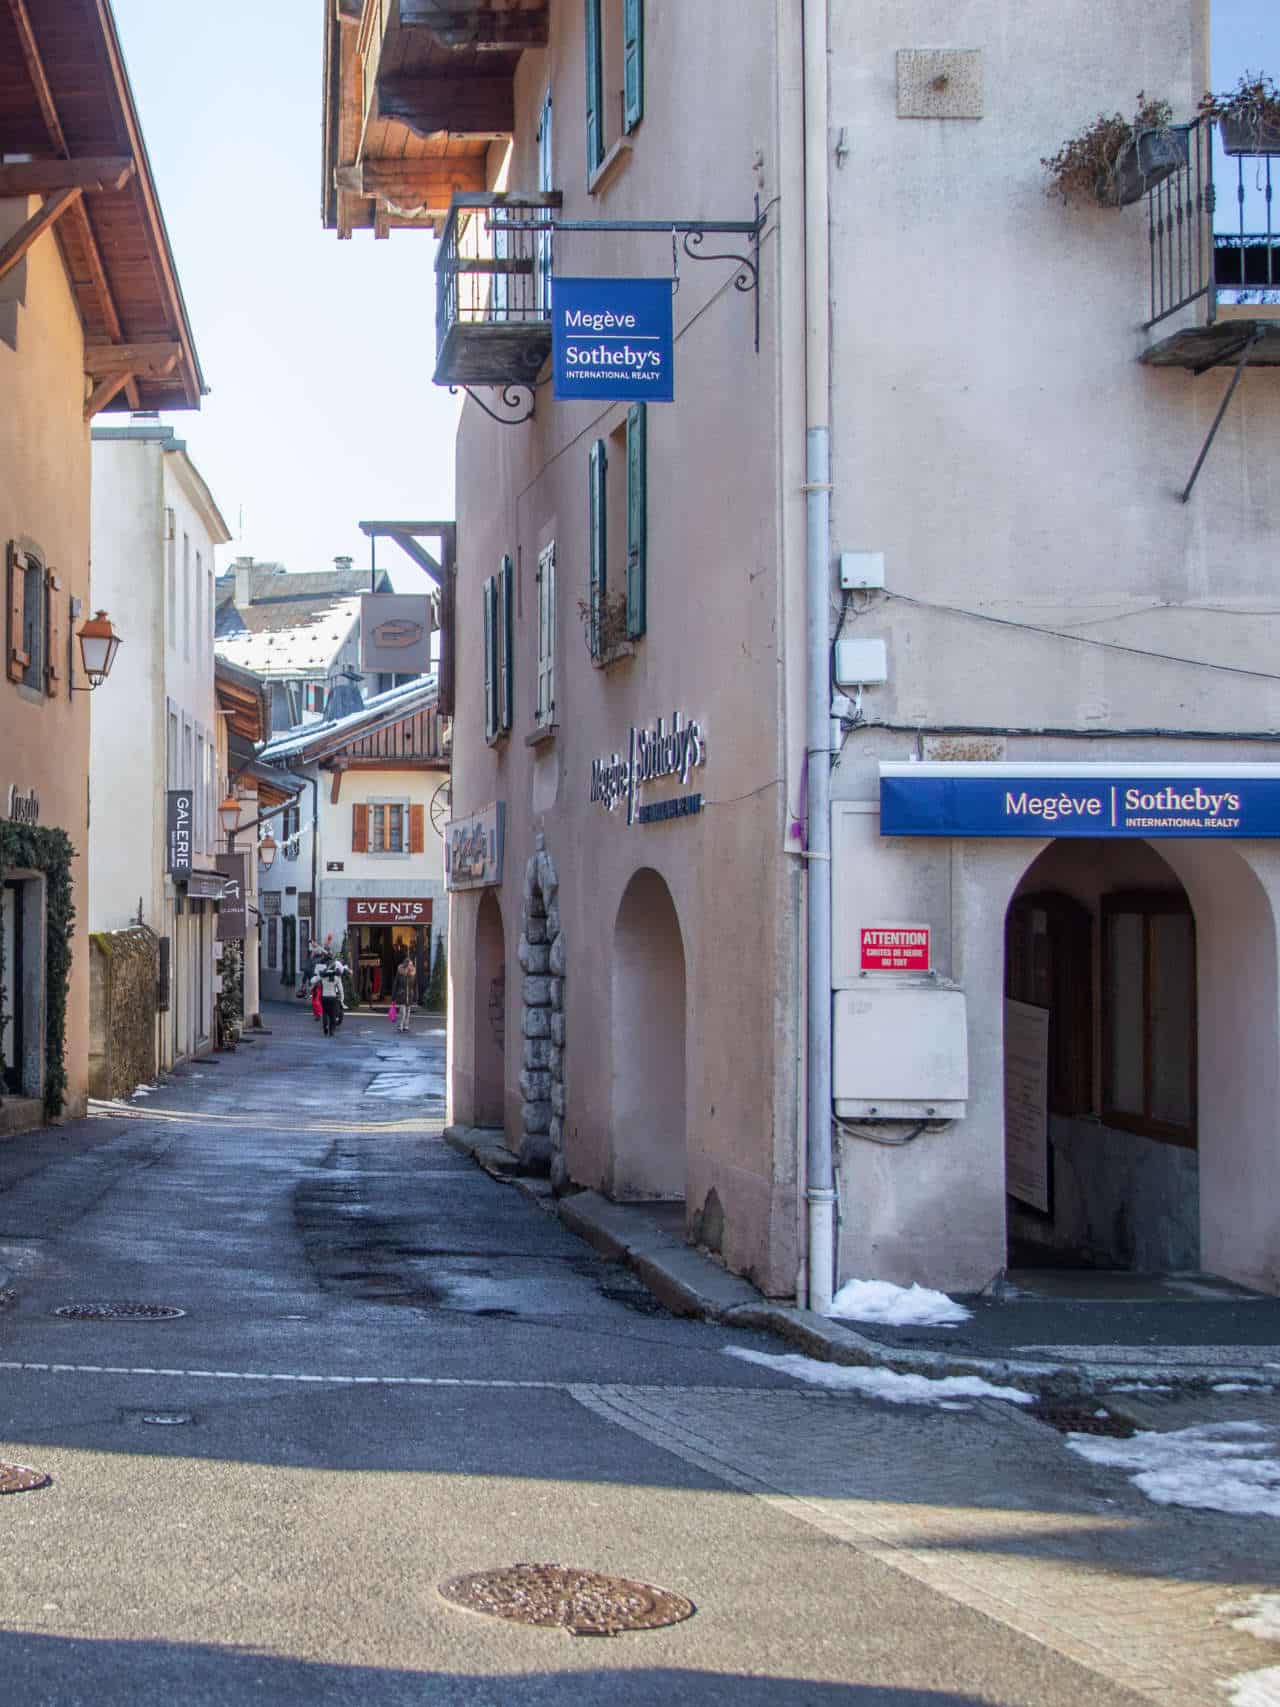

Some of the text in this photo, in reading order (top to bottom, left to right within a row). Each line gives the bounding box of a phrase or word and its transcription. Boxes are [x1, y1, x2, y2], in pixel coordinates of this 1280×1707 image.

[565, 310, 636, 331] Megève
[566, 345, 661, 369] Sotheby's
[566, 371, 660, 380] INTERNATIONAL REALTY
[1006, 786, 1240, 820] Megève Sotheby's
[1126, 818, 1240, 828] INTERNATIONAL REALTY
[176, 797, 189, 868] GALERIE
[357, 903, 424, 914] EVENTS
[863, 931, 926, 945] ATTENTION
